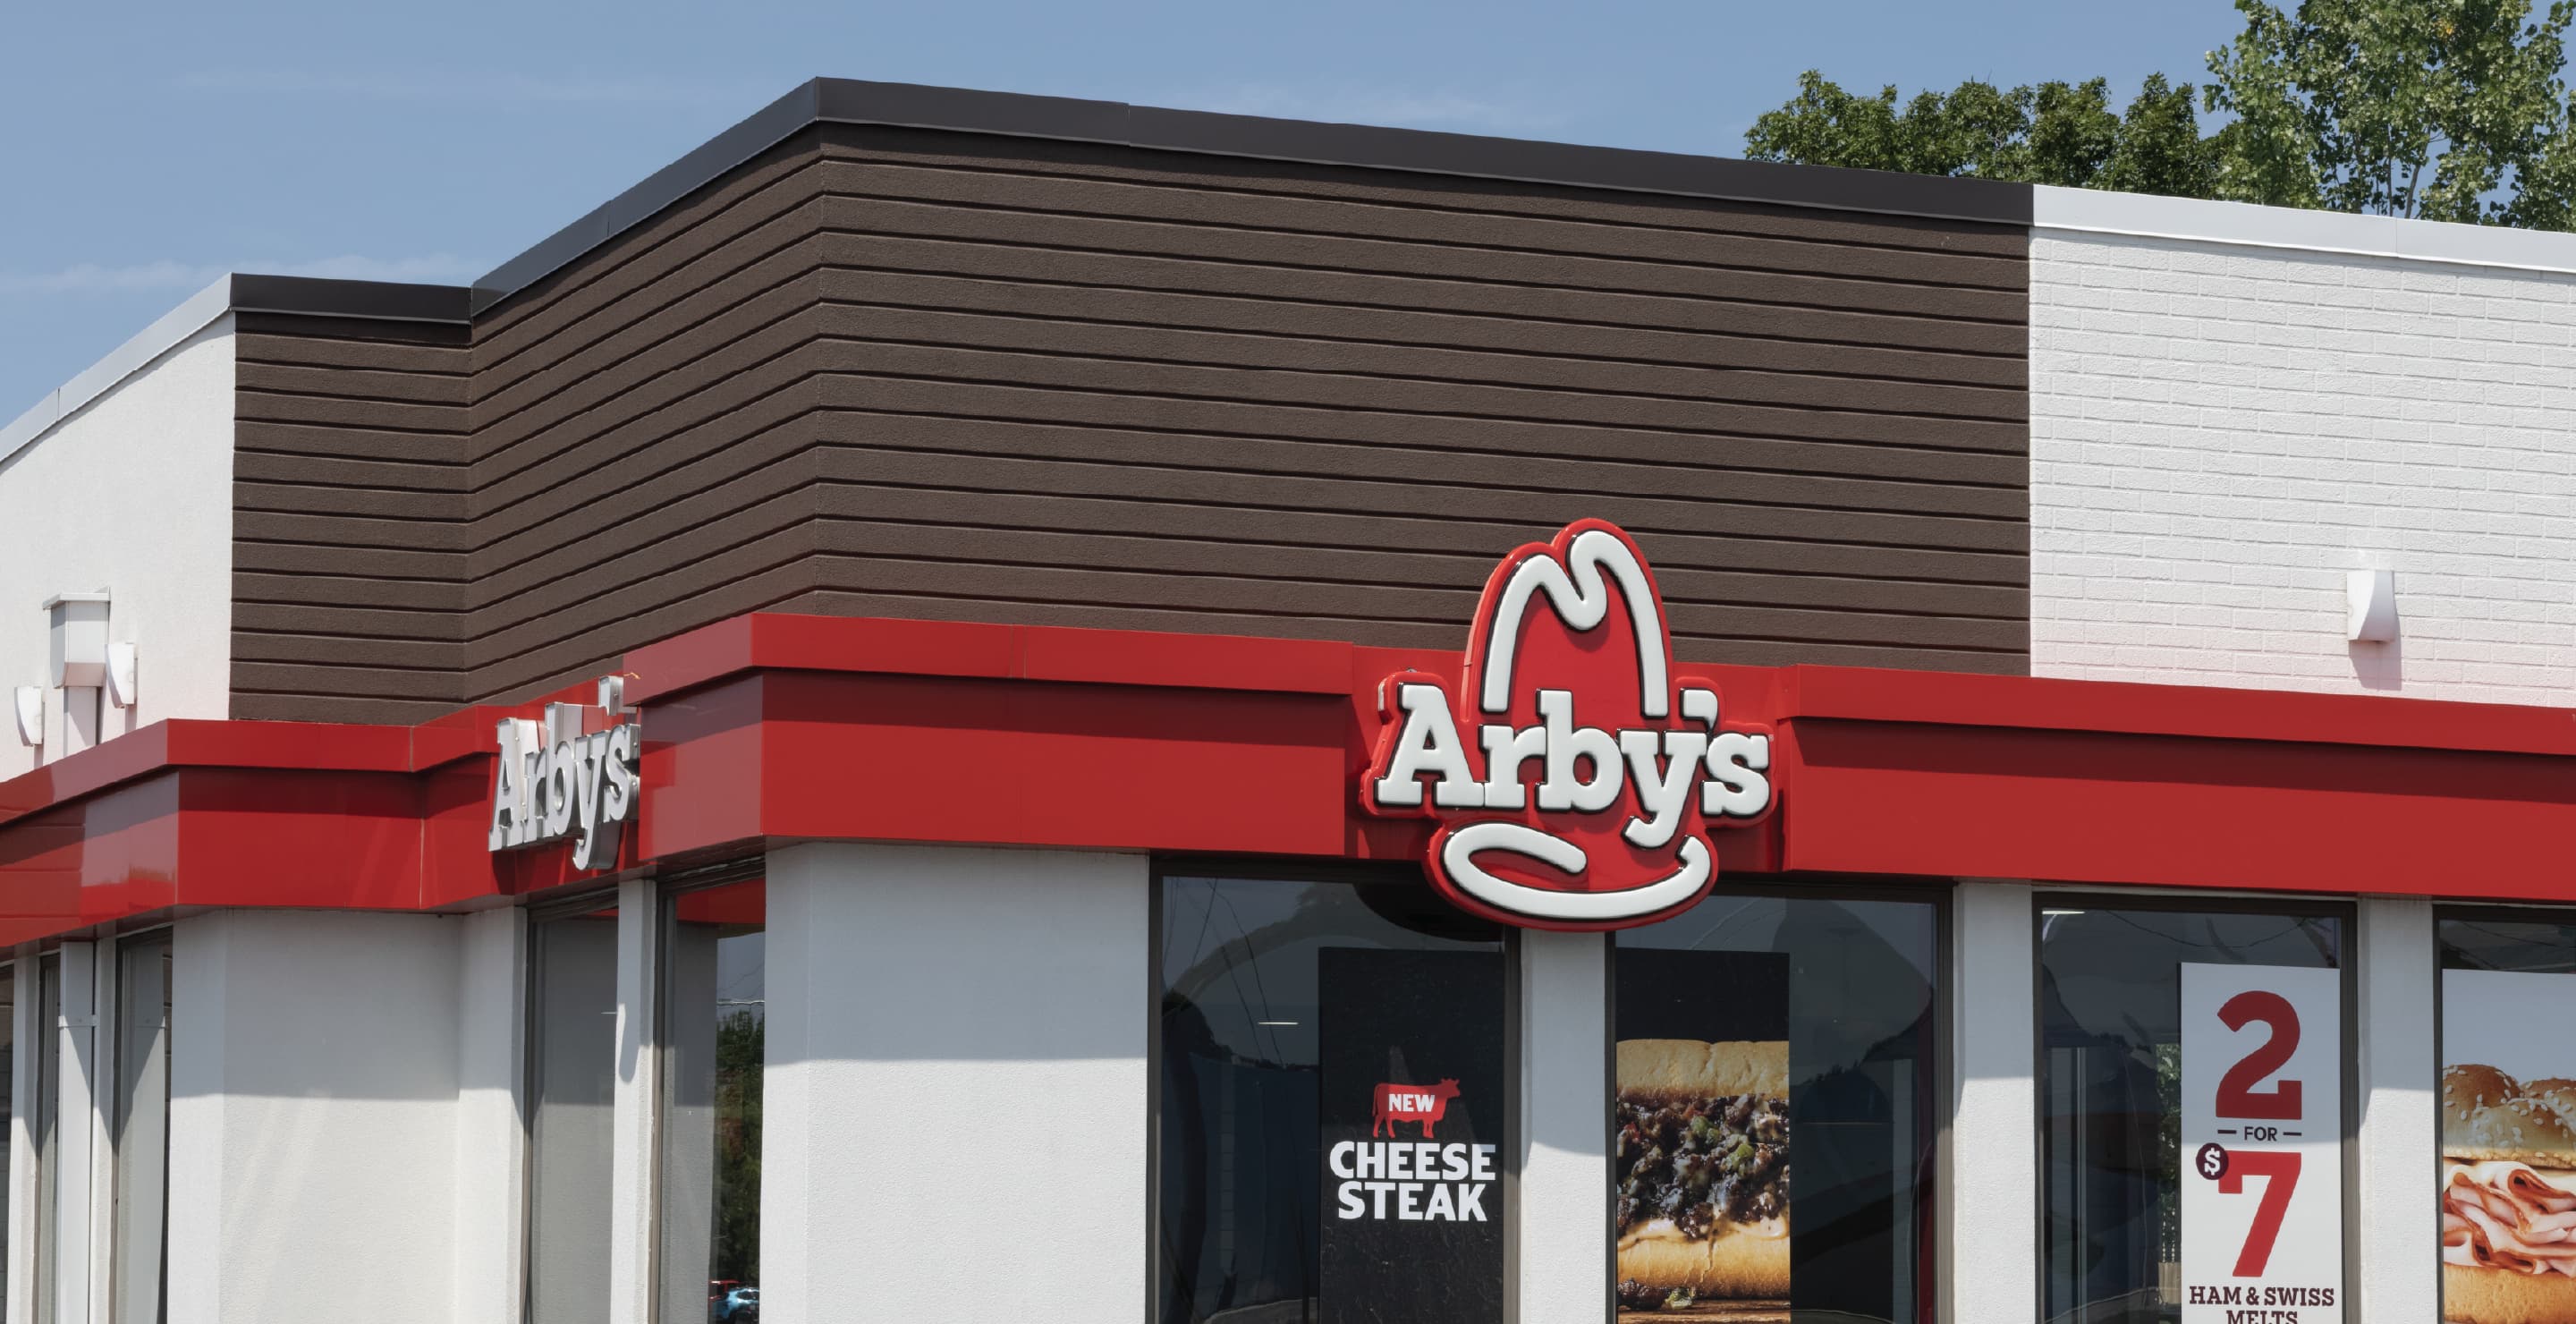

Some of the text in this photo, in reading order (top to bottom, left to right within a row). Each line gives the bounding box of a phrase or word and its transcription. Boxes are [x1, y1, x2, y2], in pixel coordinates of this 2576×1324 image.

[488, 675, 636, 870] Arby's
[1375, 683, 1770, 850] Arby's
[2216, 989, 2302, 1120] 2
[1388, 1093, 1436, 1113] NEW
[2243, 1125, 2277, 1142] FOR
[1329, 1140, 1496, 1181] CHEESE
[1337, 1180, 1487, 1222] STEAK
[2189, 1286, 2335, 1307] HAM & SWISS
[2225, 1310, 2299, 1324] MELTS
